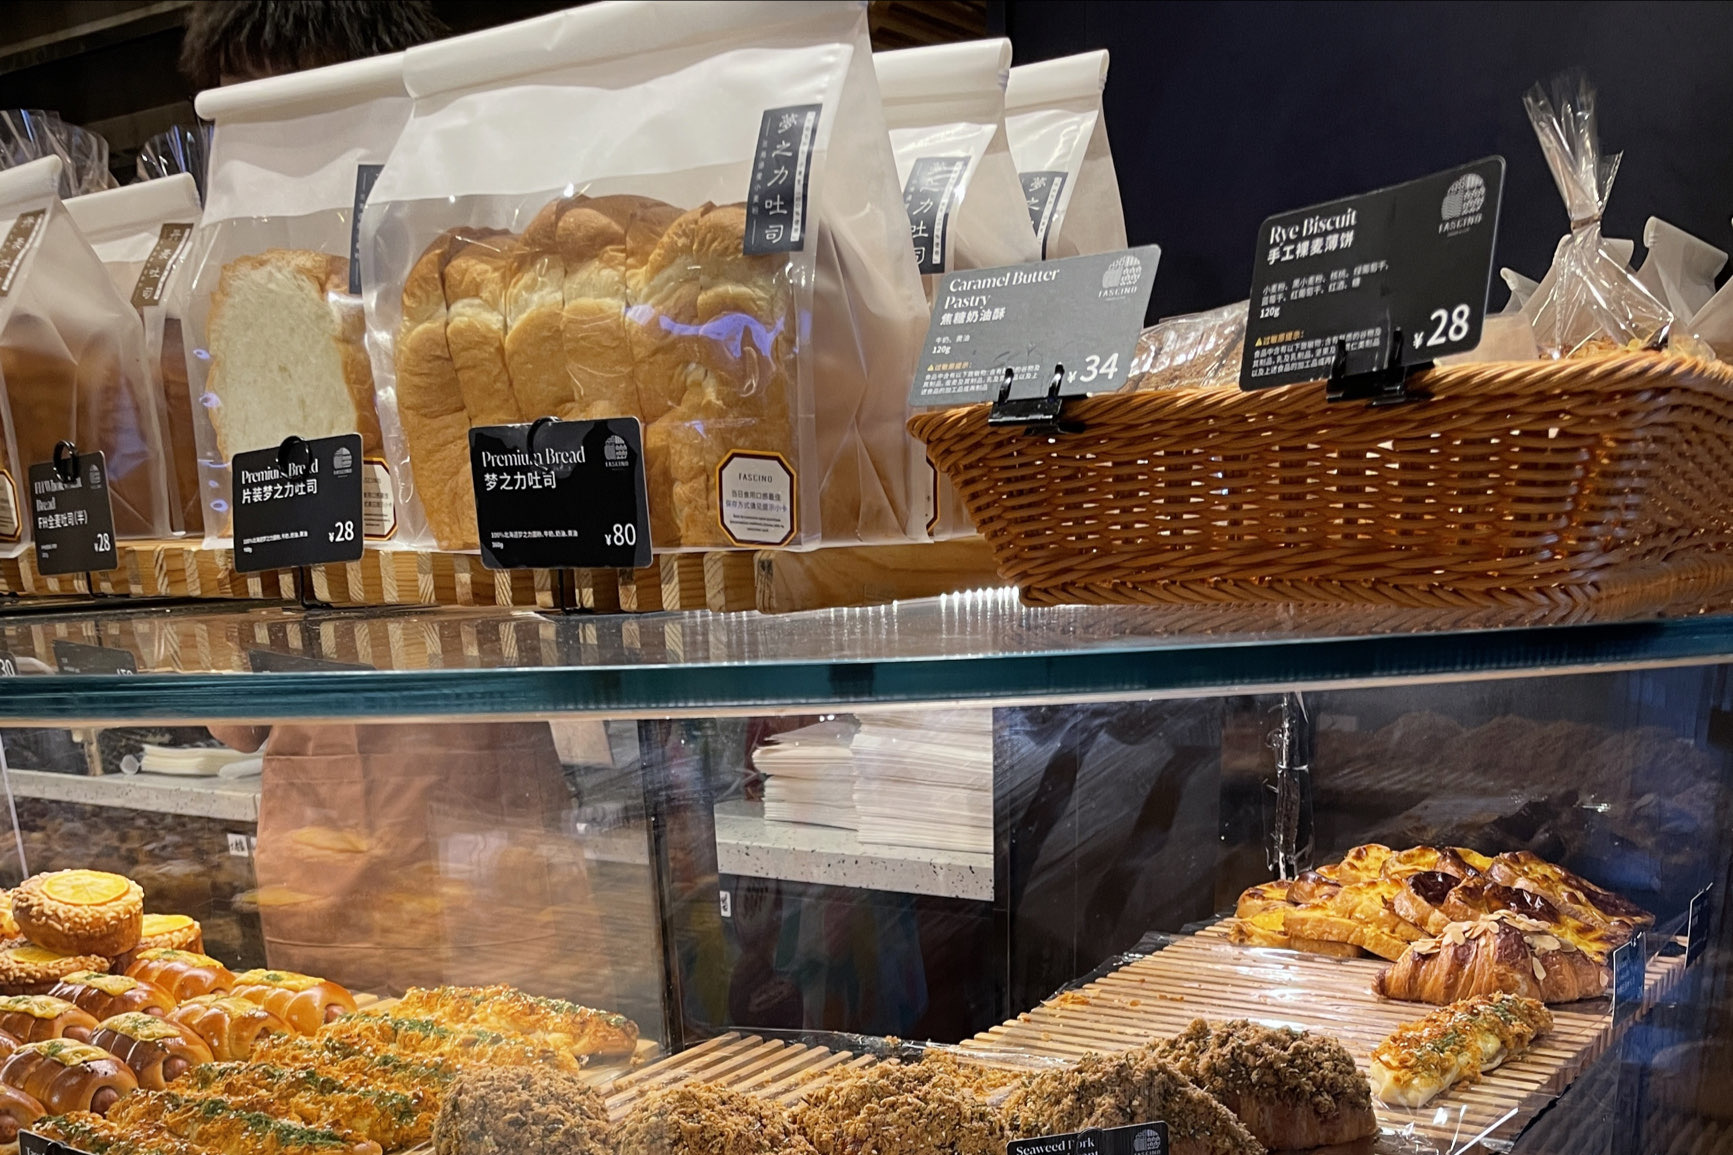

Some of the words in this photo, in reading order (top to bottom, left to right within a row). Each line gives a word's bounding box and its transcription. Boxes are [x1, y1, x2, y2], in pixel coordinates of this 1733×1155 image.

[1269, 224, 1300, 247] Rye
[1303, 206, 1358, 237] Biscuit
[949, 272, 1010, 293] Caramel
[1012, 268, 1060, 286] Butter
[944, 294, 991, 310] Pastry
[1260, 306, 1281, 319] 120g
[1413, 303, 1471, 350] ¥28
[932, 346, 951, 355] 120g
[1067, 352, 1119, 384] ¥34
[288, 458, 319, 477] Bred
[481, 449, 543, 468] Premium
[546, 446, 586, 465] Bread
[241, 478, 318, 505] 片装梦之力吐司
[484, 471, 556, 491] 梦之力吐司
[328, 521, 354, 543] ¥28
[605, 523, 637, 546] ¥80
